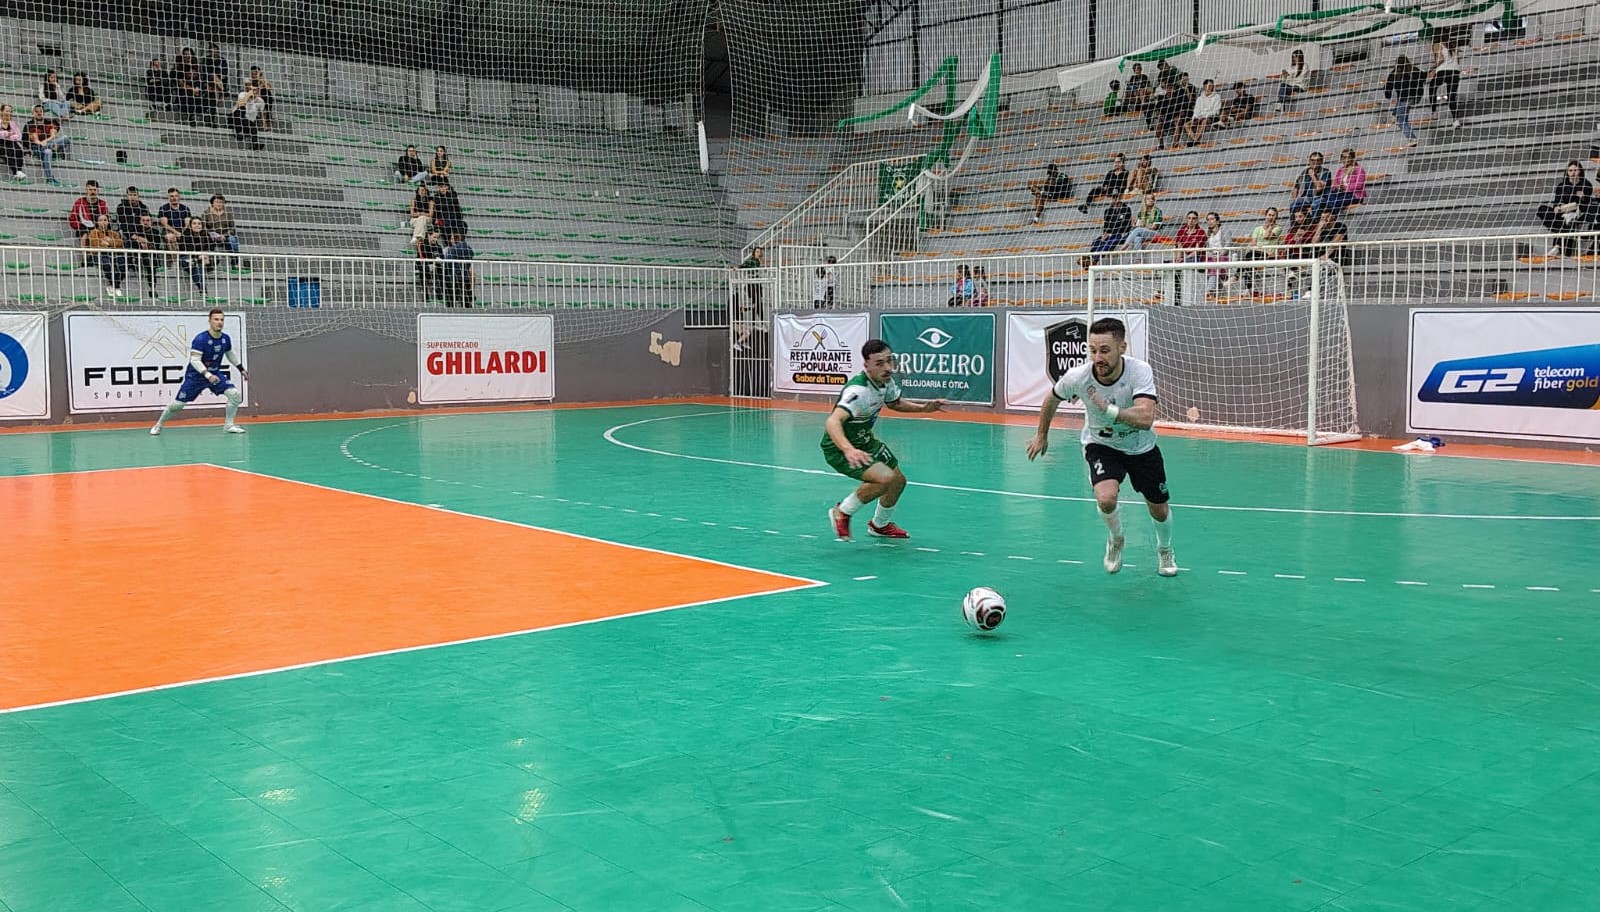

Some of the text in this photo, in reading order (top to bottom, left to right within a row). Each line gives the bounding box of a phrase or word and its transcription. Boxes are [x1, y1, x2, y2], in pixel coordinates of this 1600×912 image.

[426, 341, 479, 349] SUPERMERCADO
[1052, 341, 1088, 355] GRING
[426, 351, 546, 375] GHILARDI
[790, 351, 852, 362] RESTAURANTE
[800, 361, 839, 372] POPULAR
[890, 352, 985, 376] CRUZEIRO
[1056, 357, 1088, 370] WOR
[1533, 365, 1585, 378] telecom
[942, 380, 948, 389] E
[1437, 367, 1526, 394] G2
[1532, 375, 1599, 393] fiber gold
[94, 391, 143, 399] SPORT
[1094, 462, 1105, 475] 2
